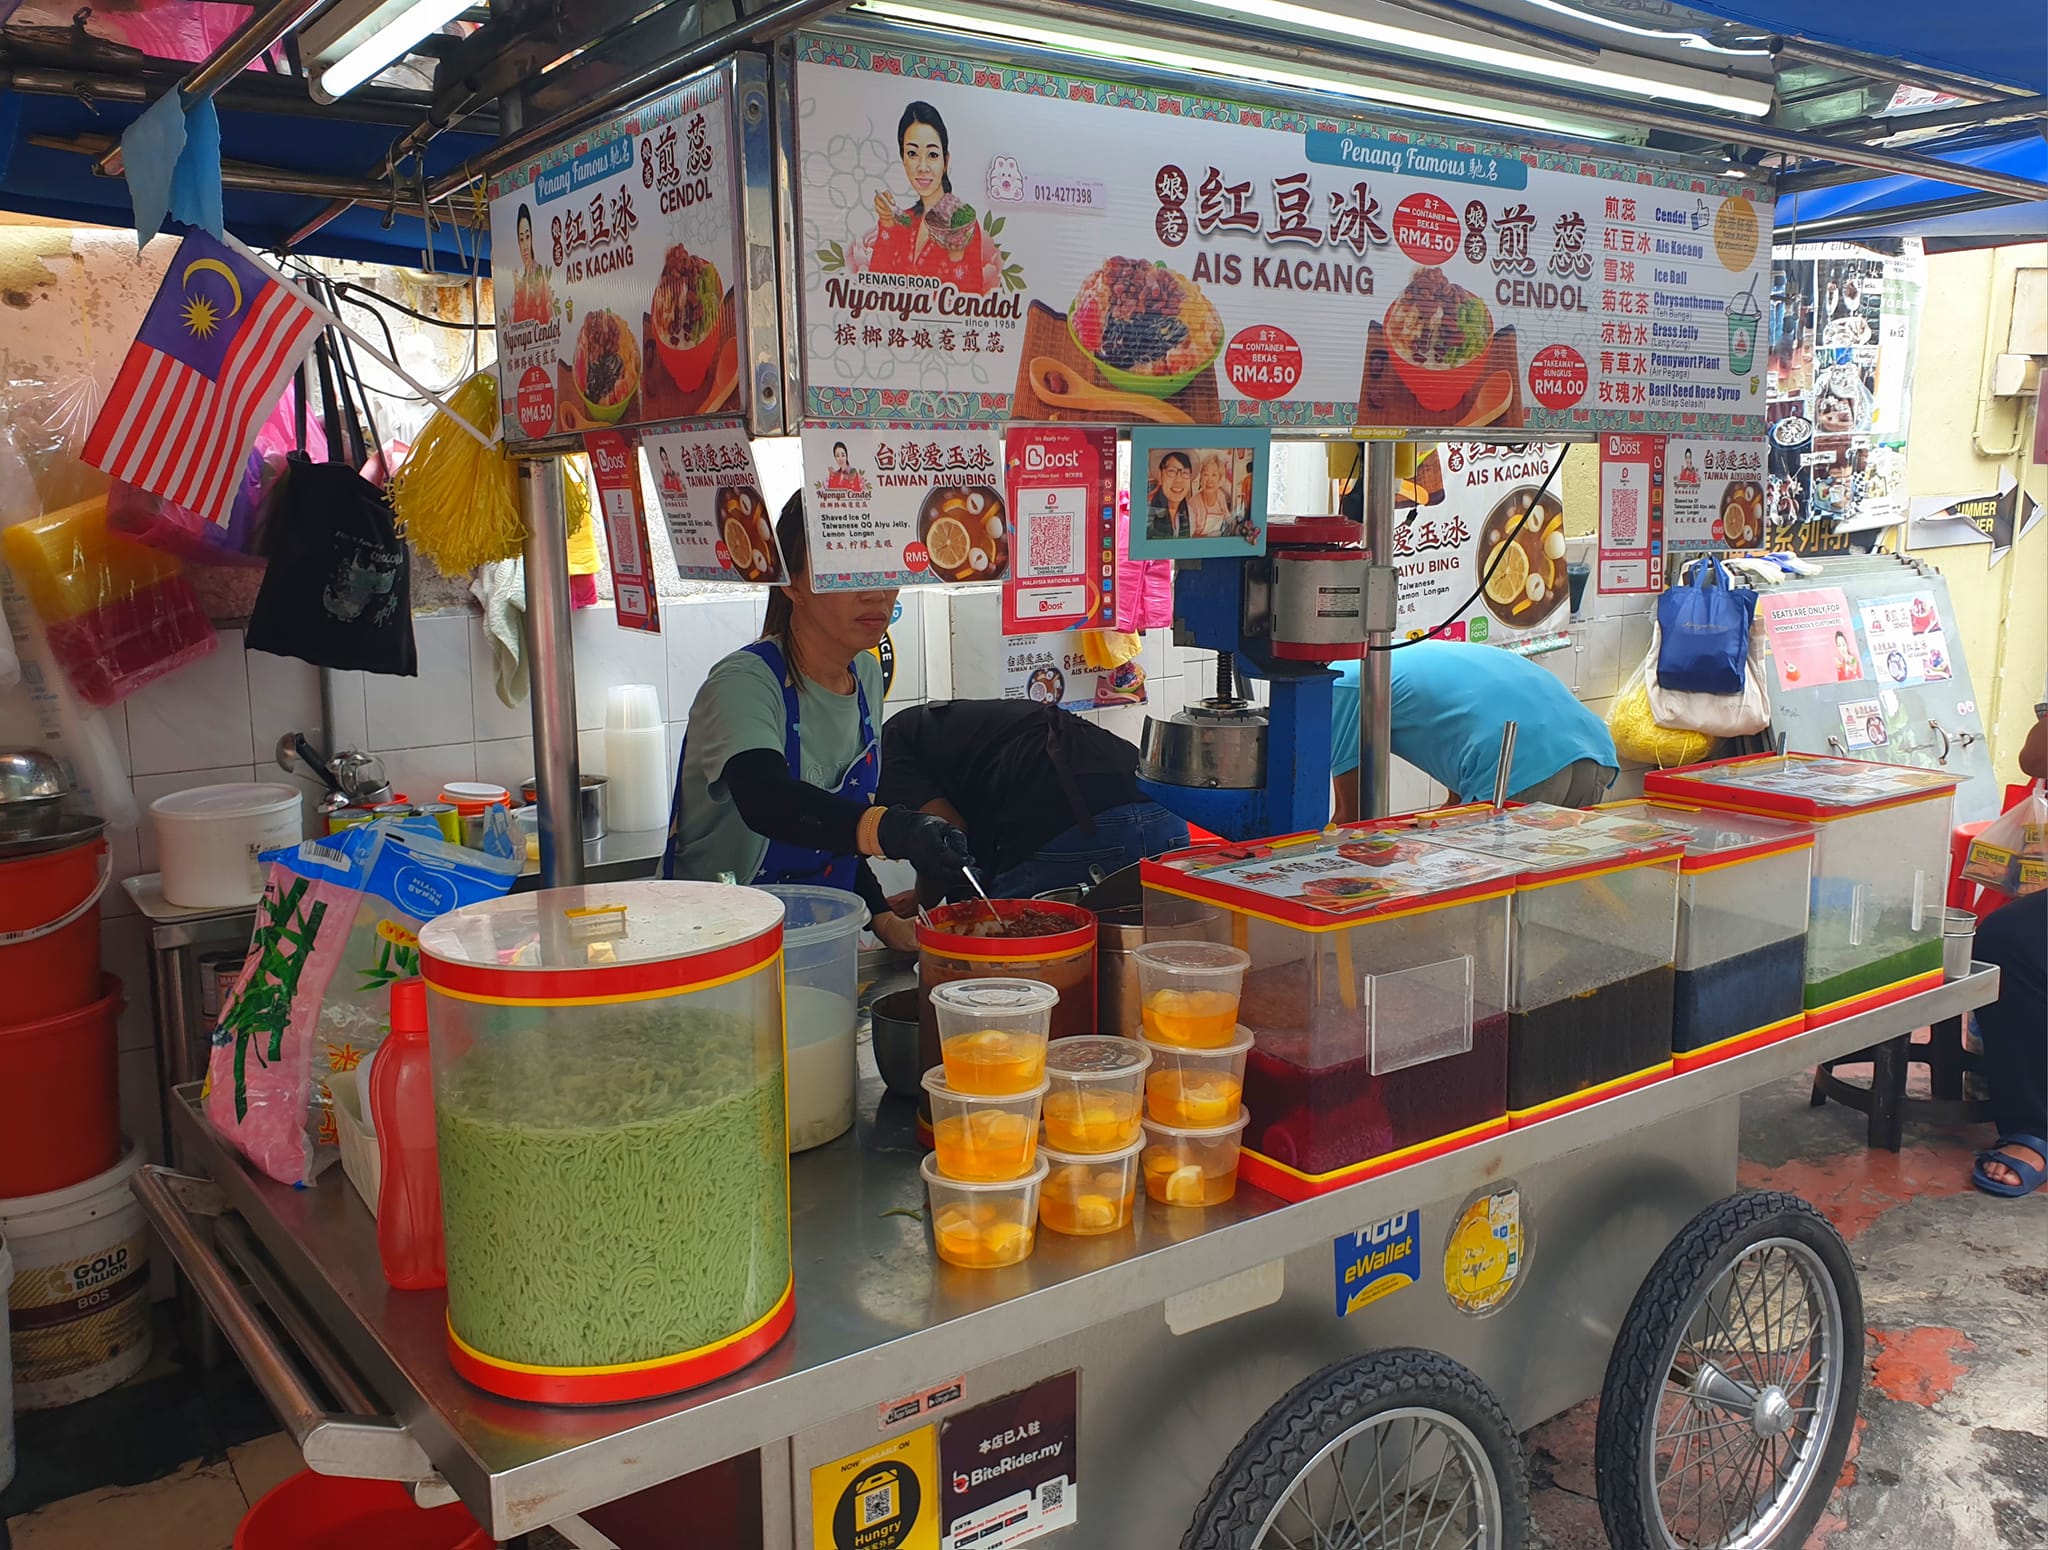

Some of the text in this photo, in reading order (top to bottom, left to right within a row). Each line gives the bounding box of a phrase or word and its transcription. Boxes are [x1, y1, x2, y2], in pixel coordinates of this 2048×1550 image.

[1340, 138, 1403, 174] Penang
[1406, 147, 1465, 177] Famous
[538, 174, 570, 198] Penang
[572, 154, 608, 184] Famous
[660, 177, 713, 215] CENDOL
[564, 184, 639, 253] 红豆冰
[1197, 165, 1391, 256] 红豆冰
[1411, 207, 1446, 222] CONTAINER
[1604, 195, 1637, 222] 煎蕊
[1655, 207, 1687, 225] Cendol
[1417, 219, 1439, 231] BEKAS
[1399, 226, 1454, 253] RM4.50
[1490, 203, 1594, 278] 煎蕊
[1603, 227, 1652, 255] 紅豆冰
[1655, 239, 1669, 254] Ais
[1671, 240, 1704, 259] Kacang
[566, 244, 634, 284] AIS KACANG
[1192, 251, 1374, 296] AIS KACANG
[1603, 258, 1635, 284] 雪球
[859, 272, 940, 290] PENANG ROAD
[1654, 268, 1687, 285] Ice Ball
[825, 278, 1022, 321] Nyonya Cendol
[1496, 278, 1588, 312] CENDOL
[1602, 288, 1650, 315] 菊花茶
[1653, 291, 1725, 312] Chrysanthemum
[965, 319, 989, 328] since
[1652, 322, 1700, 341] Grass Jelly
[1245, 343, 1284, 353] CONTAINER
[1252, 354, 1277, 363] BEKAS
[1600, 350, 1647, 376] 青草水
[1651, 352, 1720, 370] Pennywort Plant
[1233, 364, 1295, 384] RM4.50
[1535, 379, 1584, 395] RM4.00
[1650, 382, 1741, 402] Basil Seed Rose Syrup
[521, 403, 552, 424] RM4.50
[876, 441, 995, 472] 台湾爱玉冰
[686, 473, 755, 488] TAIWAN AIYU BING
[877, 473, 996, 487] TAIWAN AIYU BING
[1466, 460, 1549, 487] AIS KACANG
[1704, 472, 1728, 480] TAIWAN
[1744, 472, 1761, 480] BING
[817, 490, 872, 501] Nyonya Cendol
[822, 522, 858, 530] Taiwanese
[874, 521, 890, 530] Aiyu
[861, 513, 870, 521] Of
[849, 530, 875, 538] Longan
[906, 551, 928, 562] RM5
[1429, 557, 1459, 571] BING
[1397, 586, 1450, 600] Lemon Longan
[1399, 579, 1435, 591] Taiwanese
[1772, 604, 1840, 619] SEATS ARE ONLY FOR
[73, 1248, 128, 1280] GOLD
[1344, 1235, 1413, 1284] eWallet
[76, 1262, 128, 1291] BULLION
[78, 1289, 110, 1310] BOS
[978, 1420, 1041, 1454] 本店已入驻
[841, 1460, 860, 1472] NOW
[898, 1440, 910, 1450] ON
[970, 1442, 1064, 1487] BiteRider.my
[855, 1520, 901, 1547] Hungry
